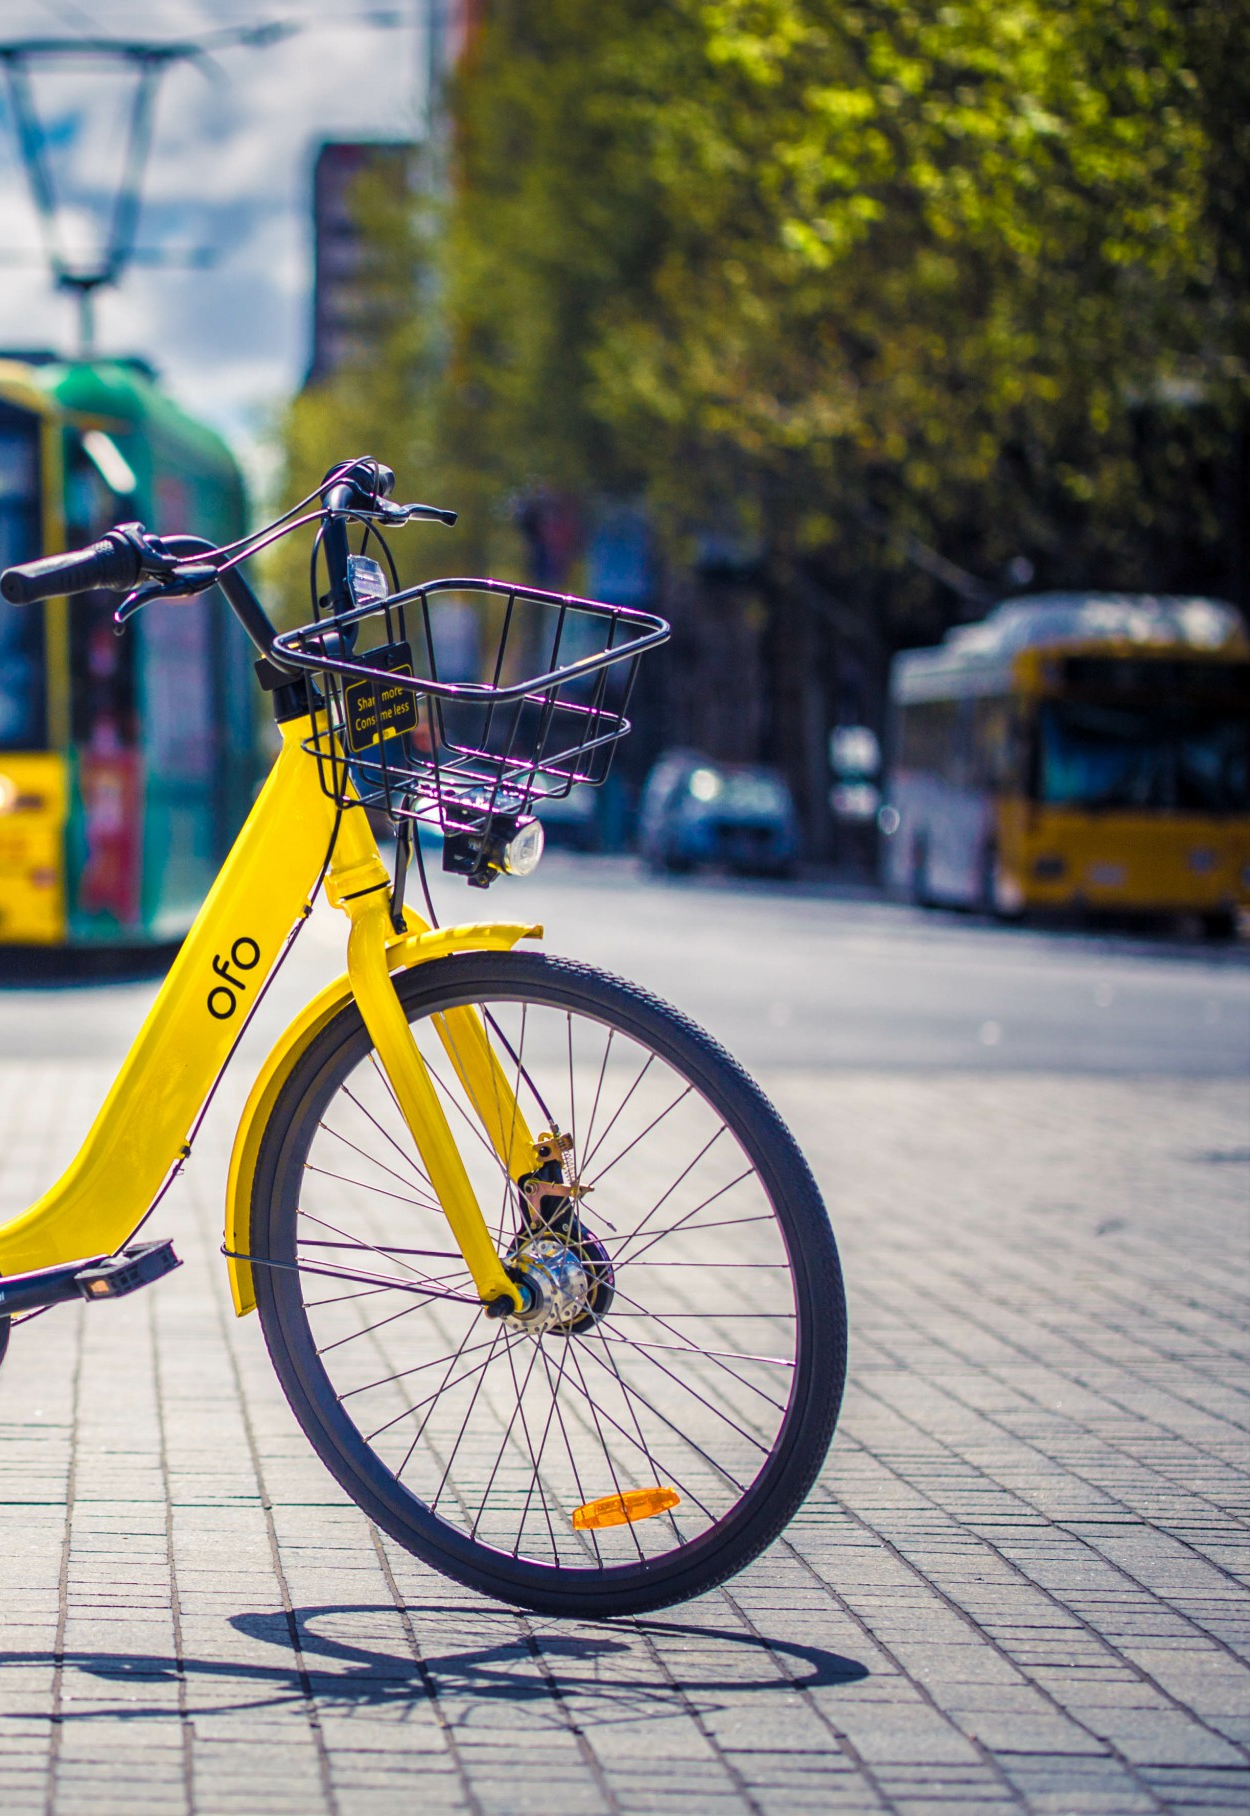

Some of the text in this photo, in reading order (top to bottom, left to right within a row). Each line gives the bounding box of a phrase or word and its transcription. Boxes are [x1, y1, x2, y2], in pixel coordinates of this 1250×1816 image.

[355, 702, 410, 731] Consme less
[357, 695, 378, 711] Shar
[207, 937, 260, 1020] ofo
